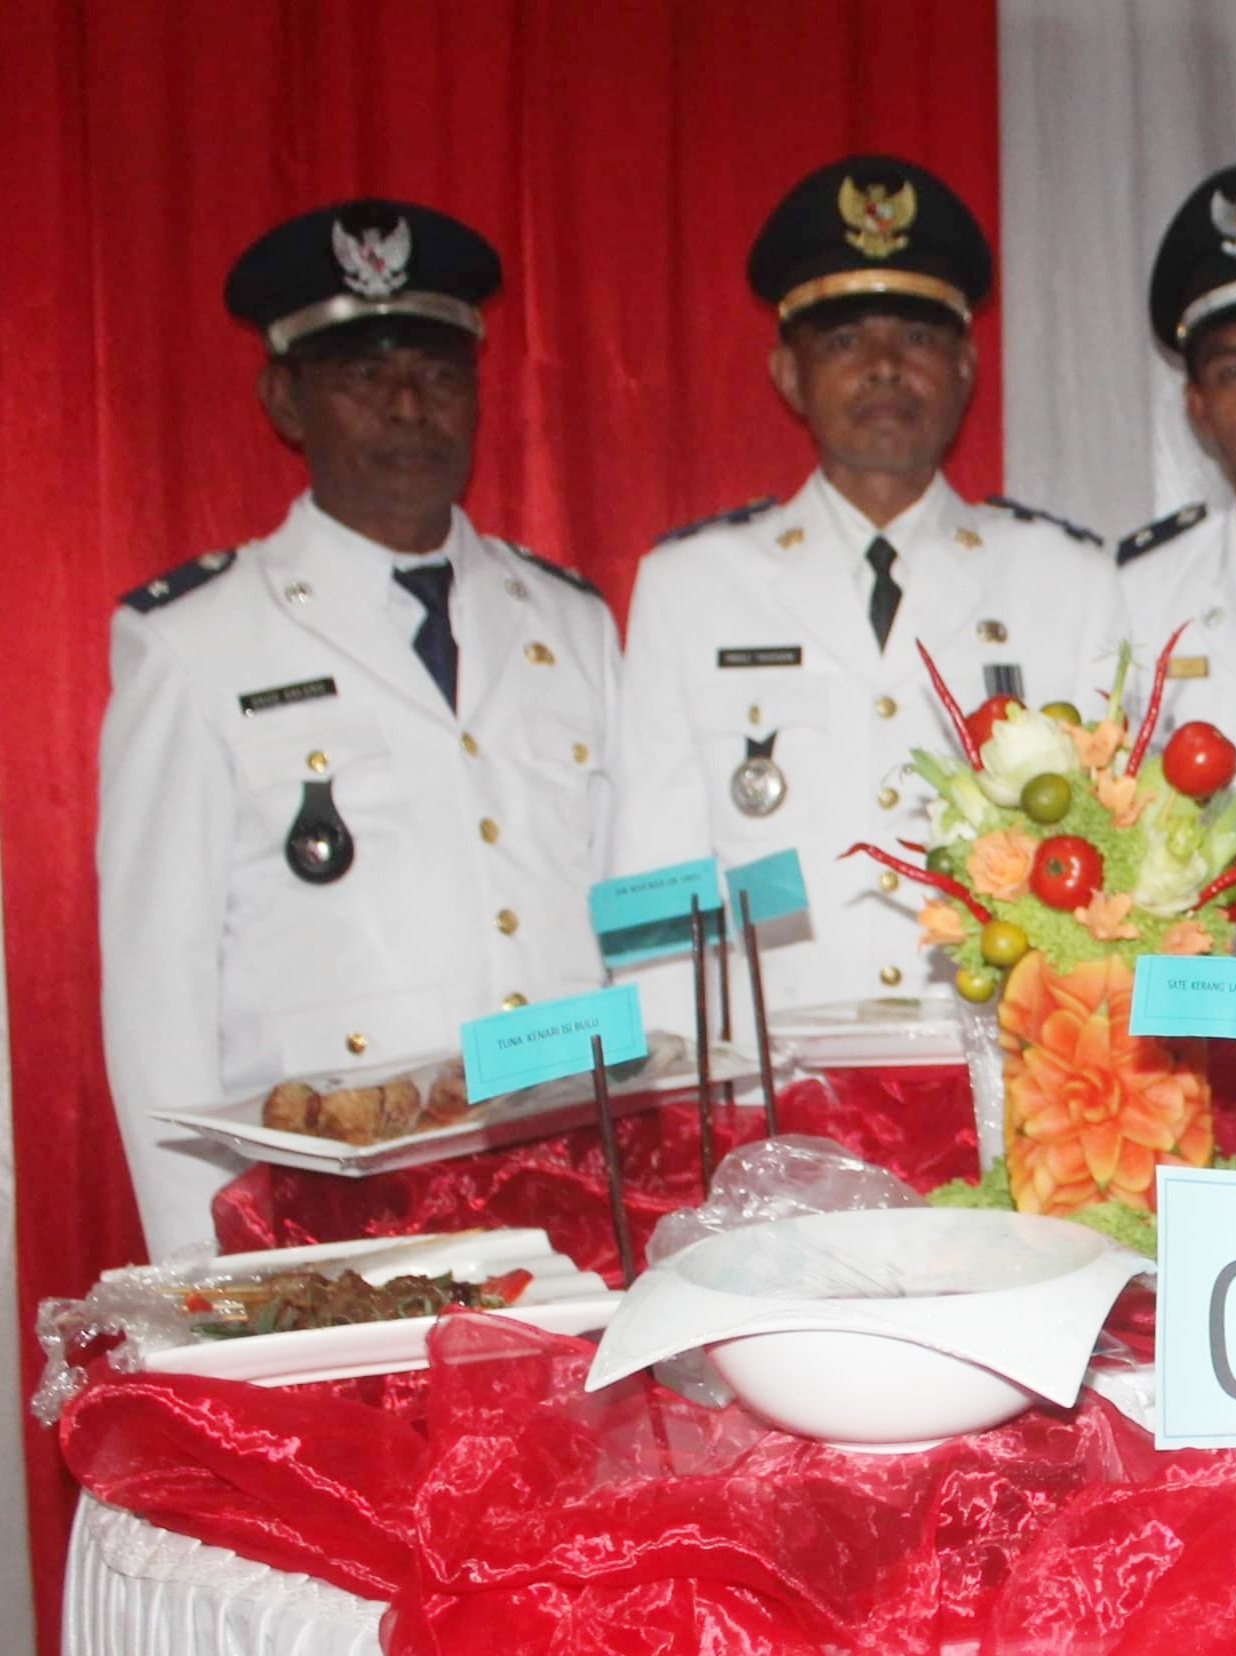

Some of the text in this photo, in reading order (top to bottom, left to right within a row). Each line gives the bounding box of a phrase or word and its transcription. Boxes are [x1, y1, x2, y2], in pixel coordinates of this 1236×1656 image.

[1167, 979, 1186, 991] SATE
[1191, 980, 1226, 993] KERANG
[497, 1036, 523, 1051] TUNA
[527, 1027, 560, 1043] KENARI
